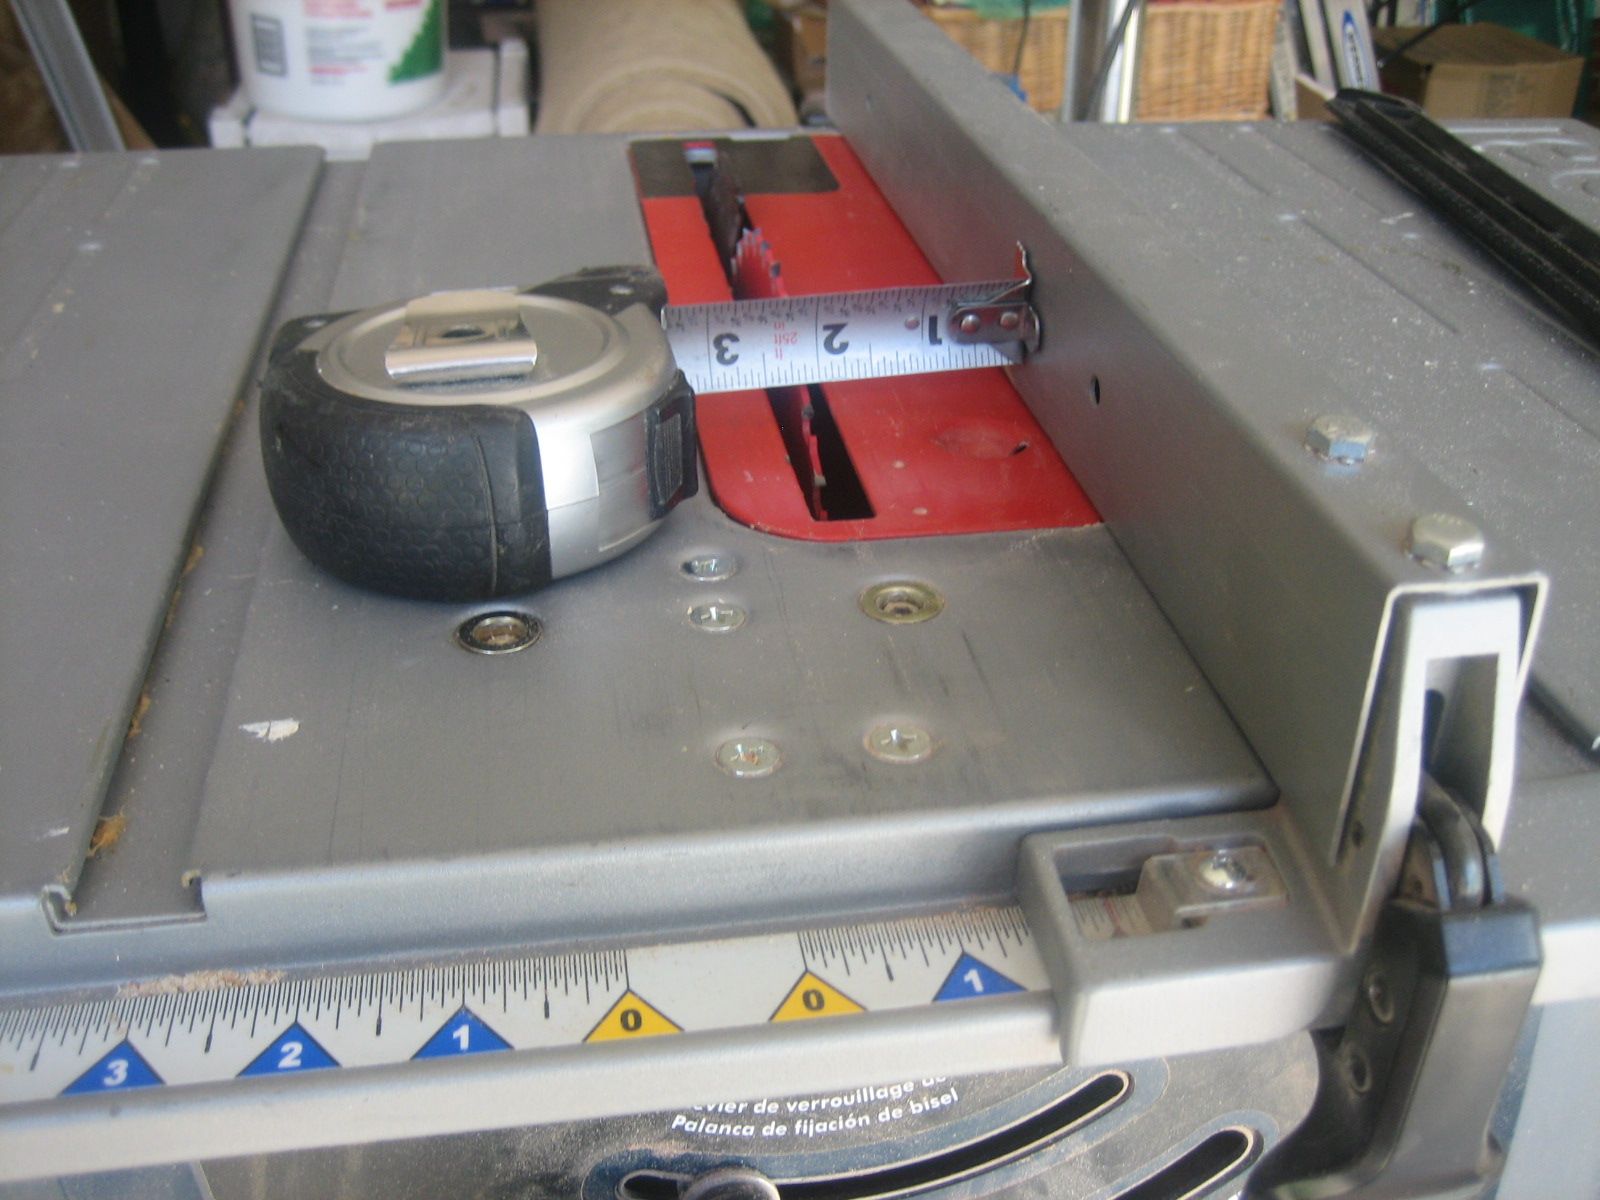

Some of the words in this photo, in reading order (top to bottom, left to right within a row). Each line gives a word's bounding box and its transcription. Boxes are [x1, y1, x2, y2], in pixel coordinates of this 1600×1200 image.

[822, 322, 849, 355] 2
[928, 315, 942, 345] 1
[713, 333, 740, 365] 3
[963, 969, 983, 992] 1
[802, 989, 825, 1011] 0
[620, 1008, 642, 1031] 0
[453, 1024, 469, 1050] 1
[278, 1041, 303, 1068] 2
[104, 1059, 128, 1086] 3
[753, 1097, 779, 1114] de
[786, 1080, 914, 1113] verrouillage
[671, 1114, 754, 1136] Palanca
[762, 1120, 787, 1137] de
[795, 1112, 870, 1138] fijación
[878, 1106, 902, 1122] de
[909, 1087, 959, 1115] bisel
